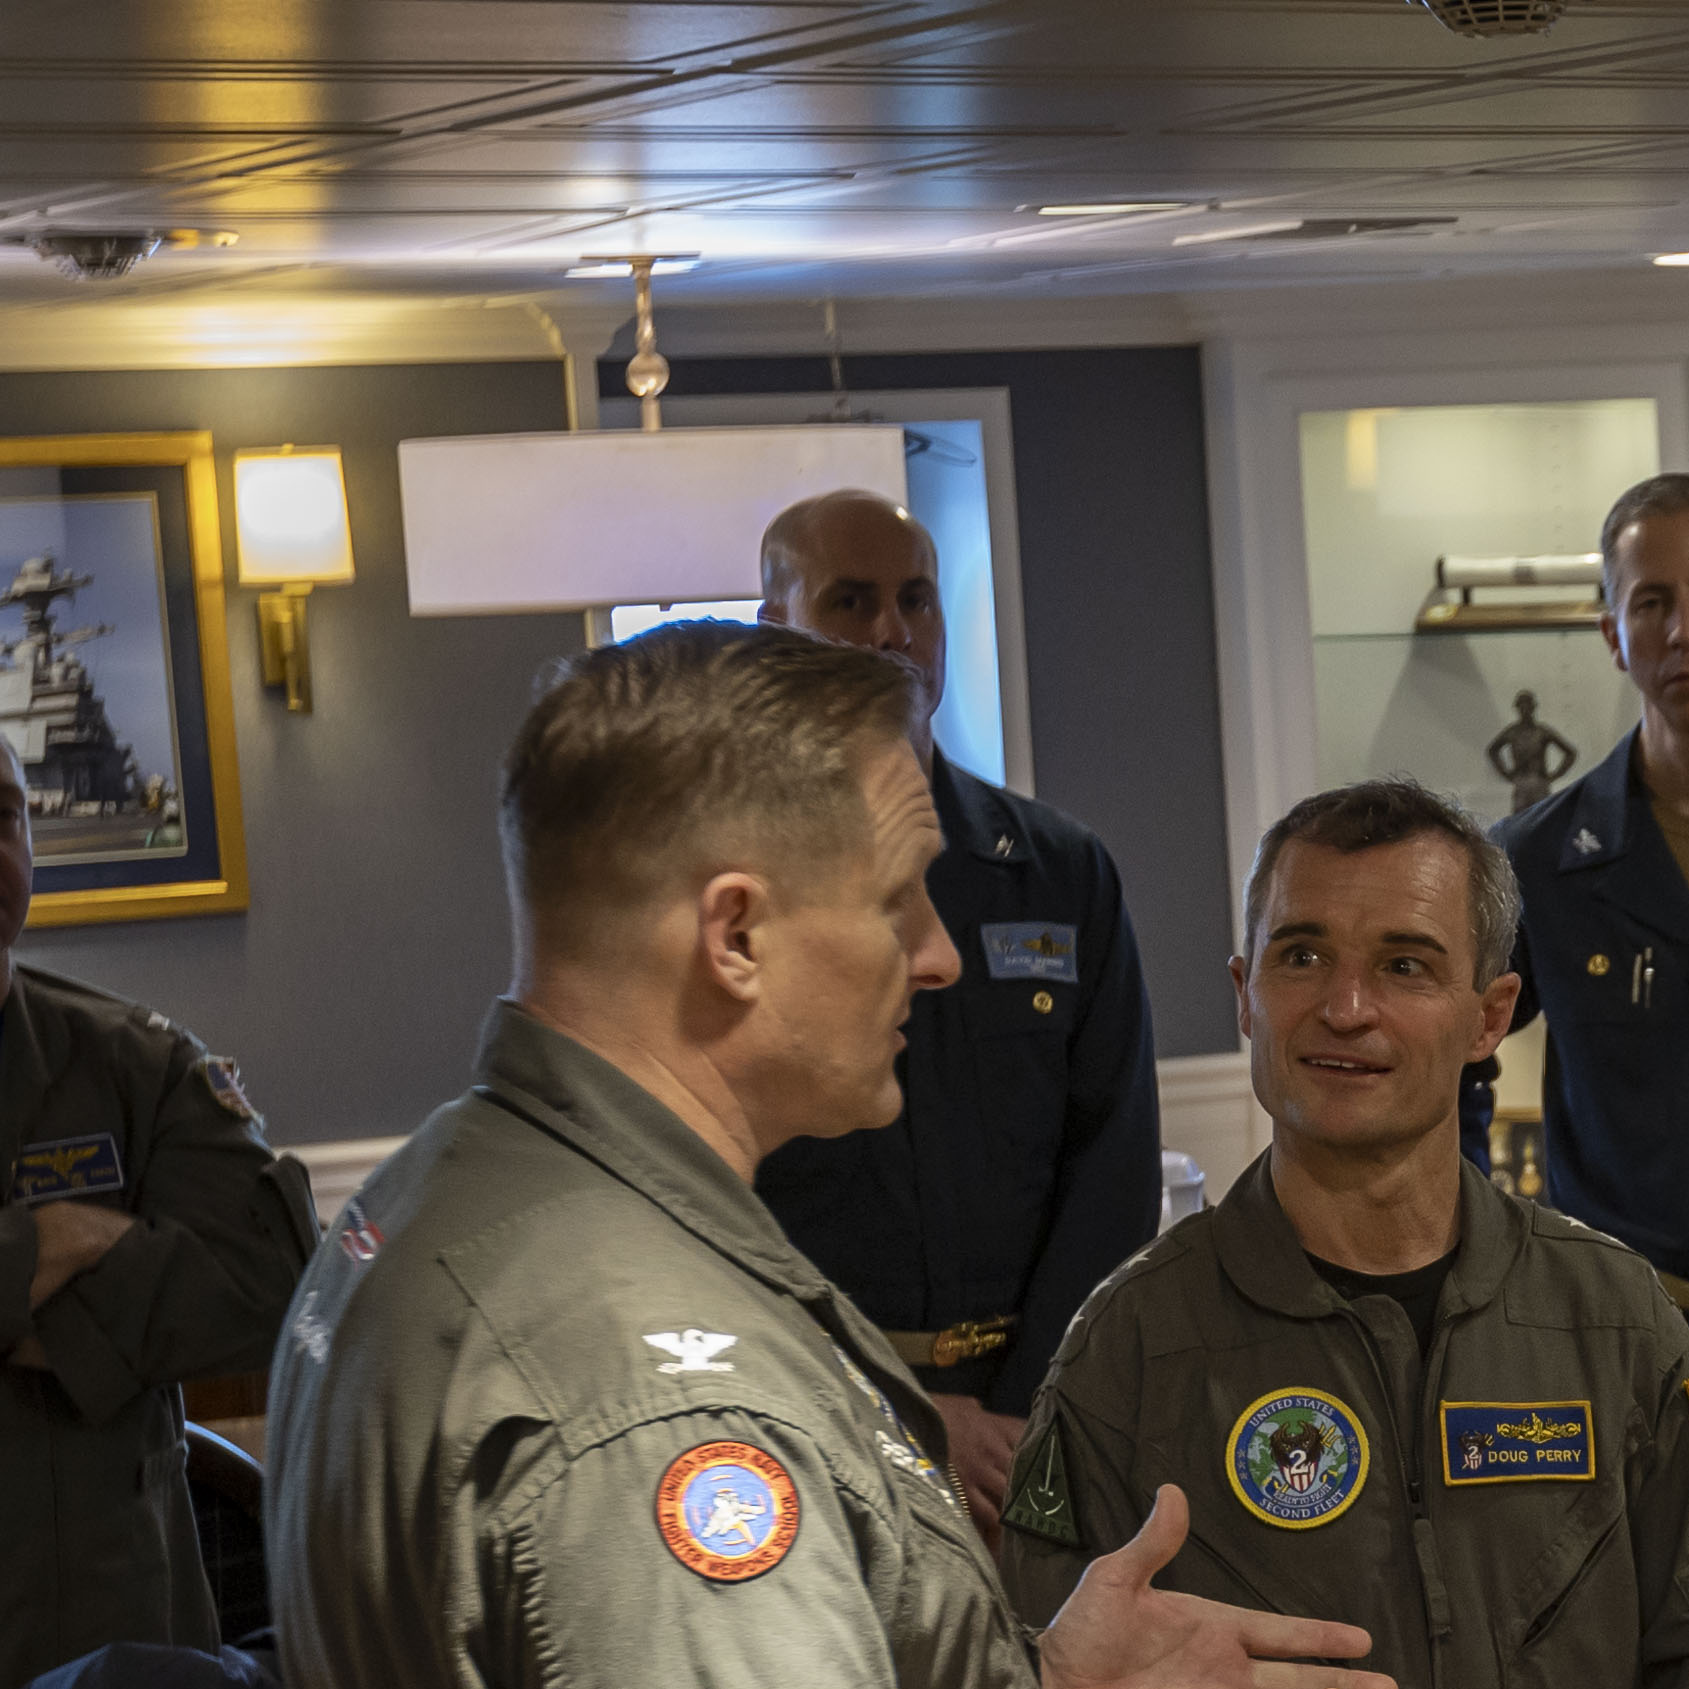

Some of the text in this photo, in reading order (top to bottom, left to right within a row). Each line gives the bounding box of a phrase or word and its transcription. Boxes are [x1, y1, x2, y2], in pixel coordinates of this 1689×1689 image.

[1249, 1397, 1336, 1428] UNITED STATES
[1288, 1449, 1311, 1475] 2
[1488, 1448, 1582, 1464] DOUG PERRY
[1259, 1489, 1345, 1519] SECOND FLEET
